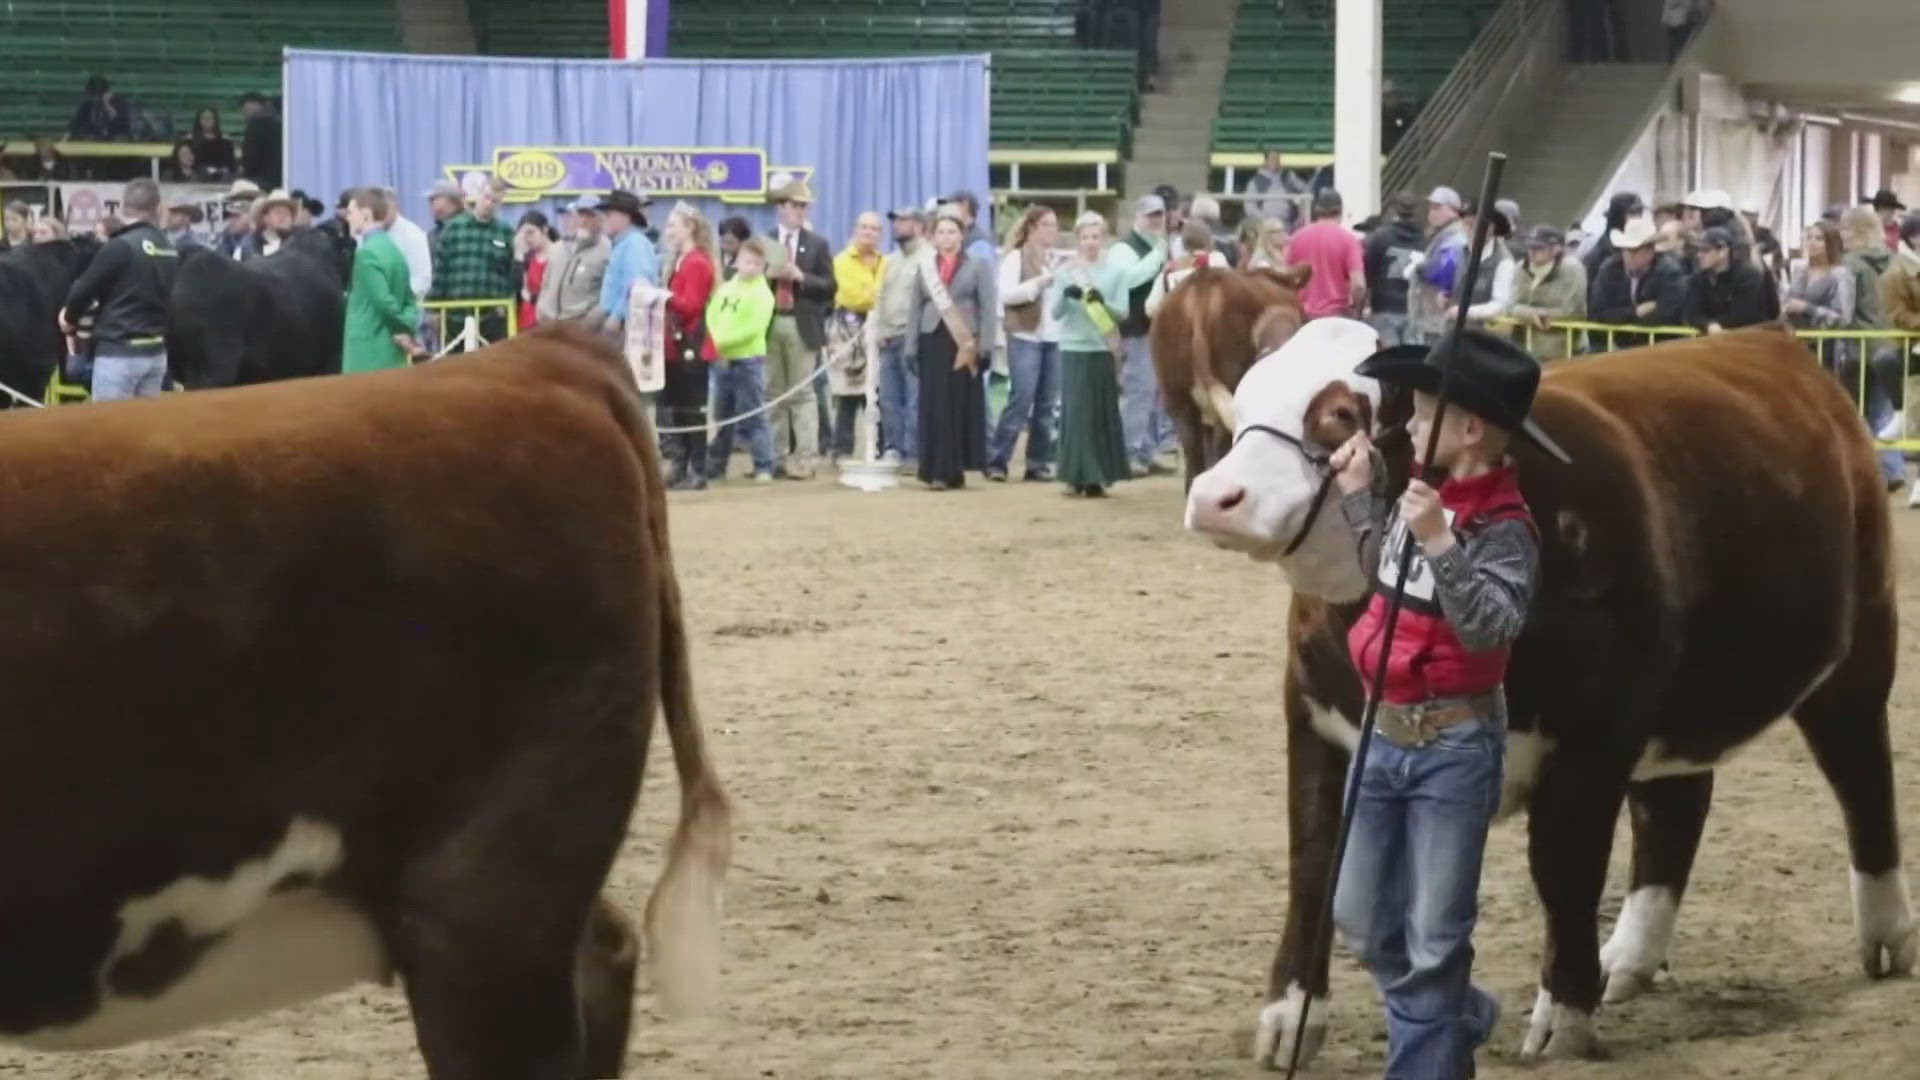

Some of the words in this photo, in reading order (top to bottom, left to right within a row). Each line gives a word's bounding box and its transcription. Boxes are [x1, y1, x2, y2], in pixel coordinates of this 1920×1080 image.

[507, 160, 558, 179] 2019
[593, 151, 695, 172] NATIONAL
[611, 169, 709, 190] WESTERN
